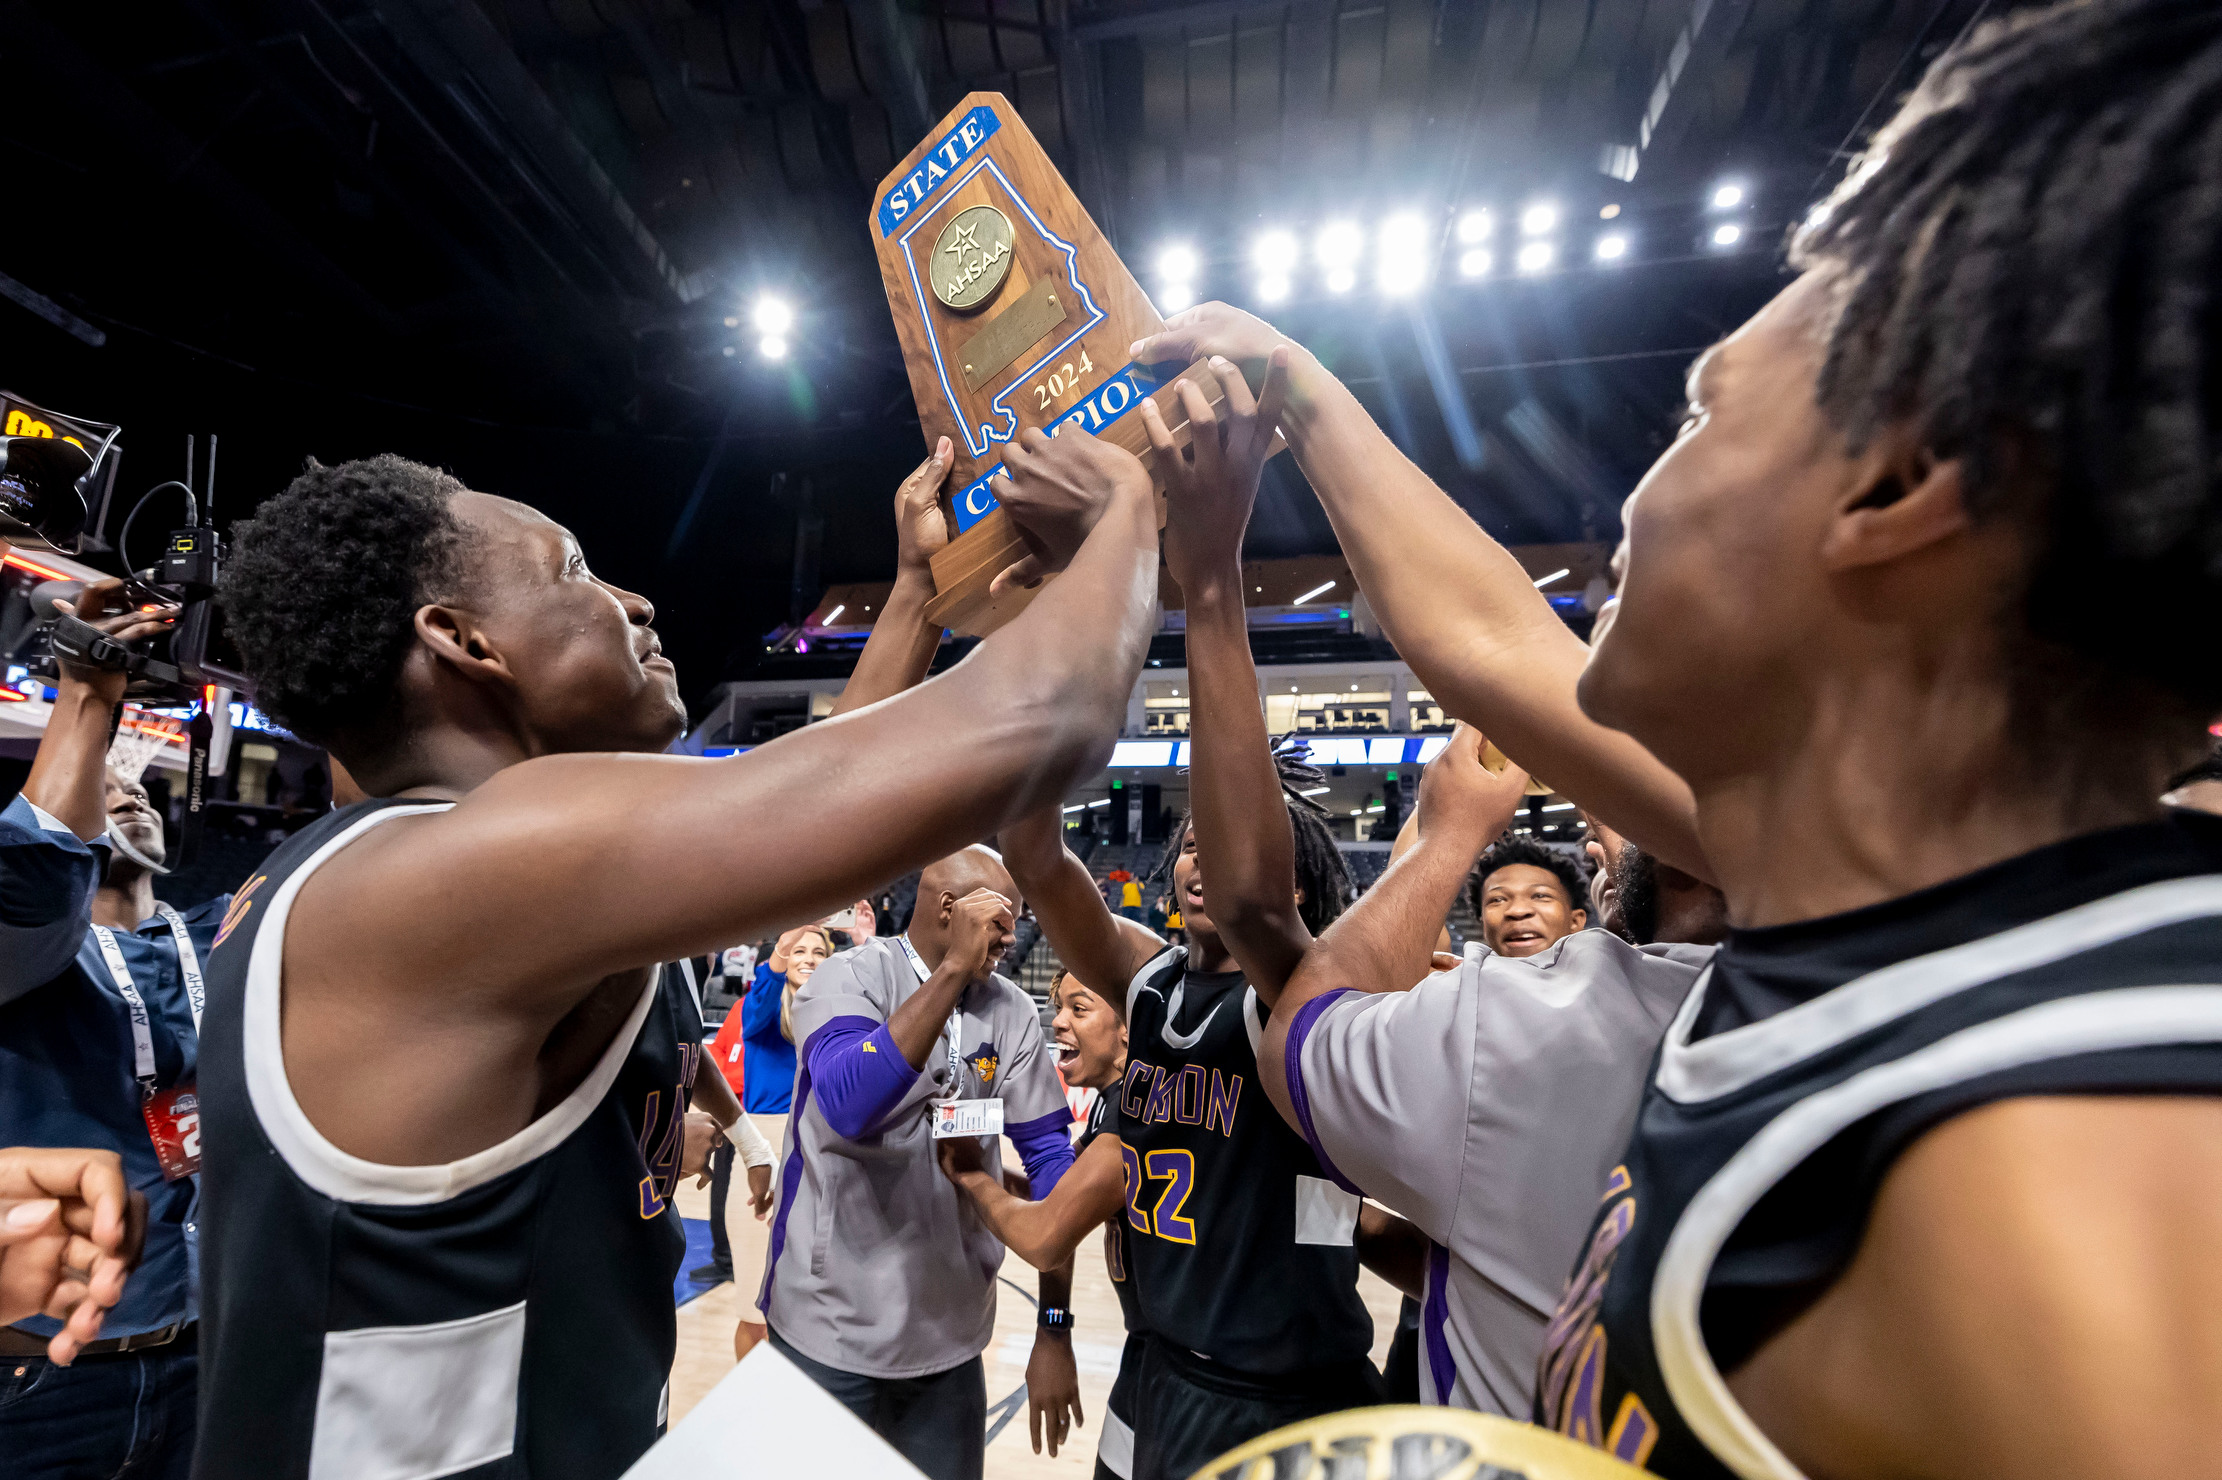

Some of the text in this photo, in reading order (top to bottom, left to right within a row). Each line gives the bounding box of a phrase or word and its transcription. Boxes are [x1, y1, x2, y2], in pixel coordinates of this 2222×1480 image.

[890, 117, 984, 221] STATE
[947, 240, 1009, 302] AHSAA
[1033, 350, 1093, 411] 2024
[123, 984, 147, 1026] AHSAA
[186, 972, 205, 1013] AHSAA
[1121, 1141, 1197, 1246] 22
